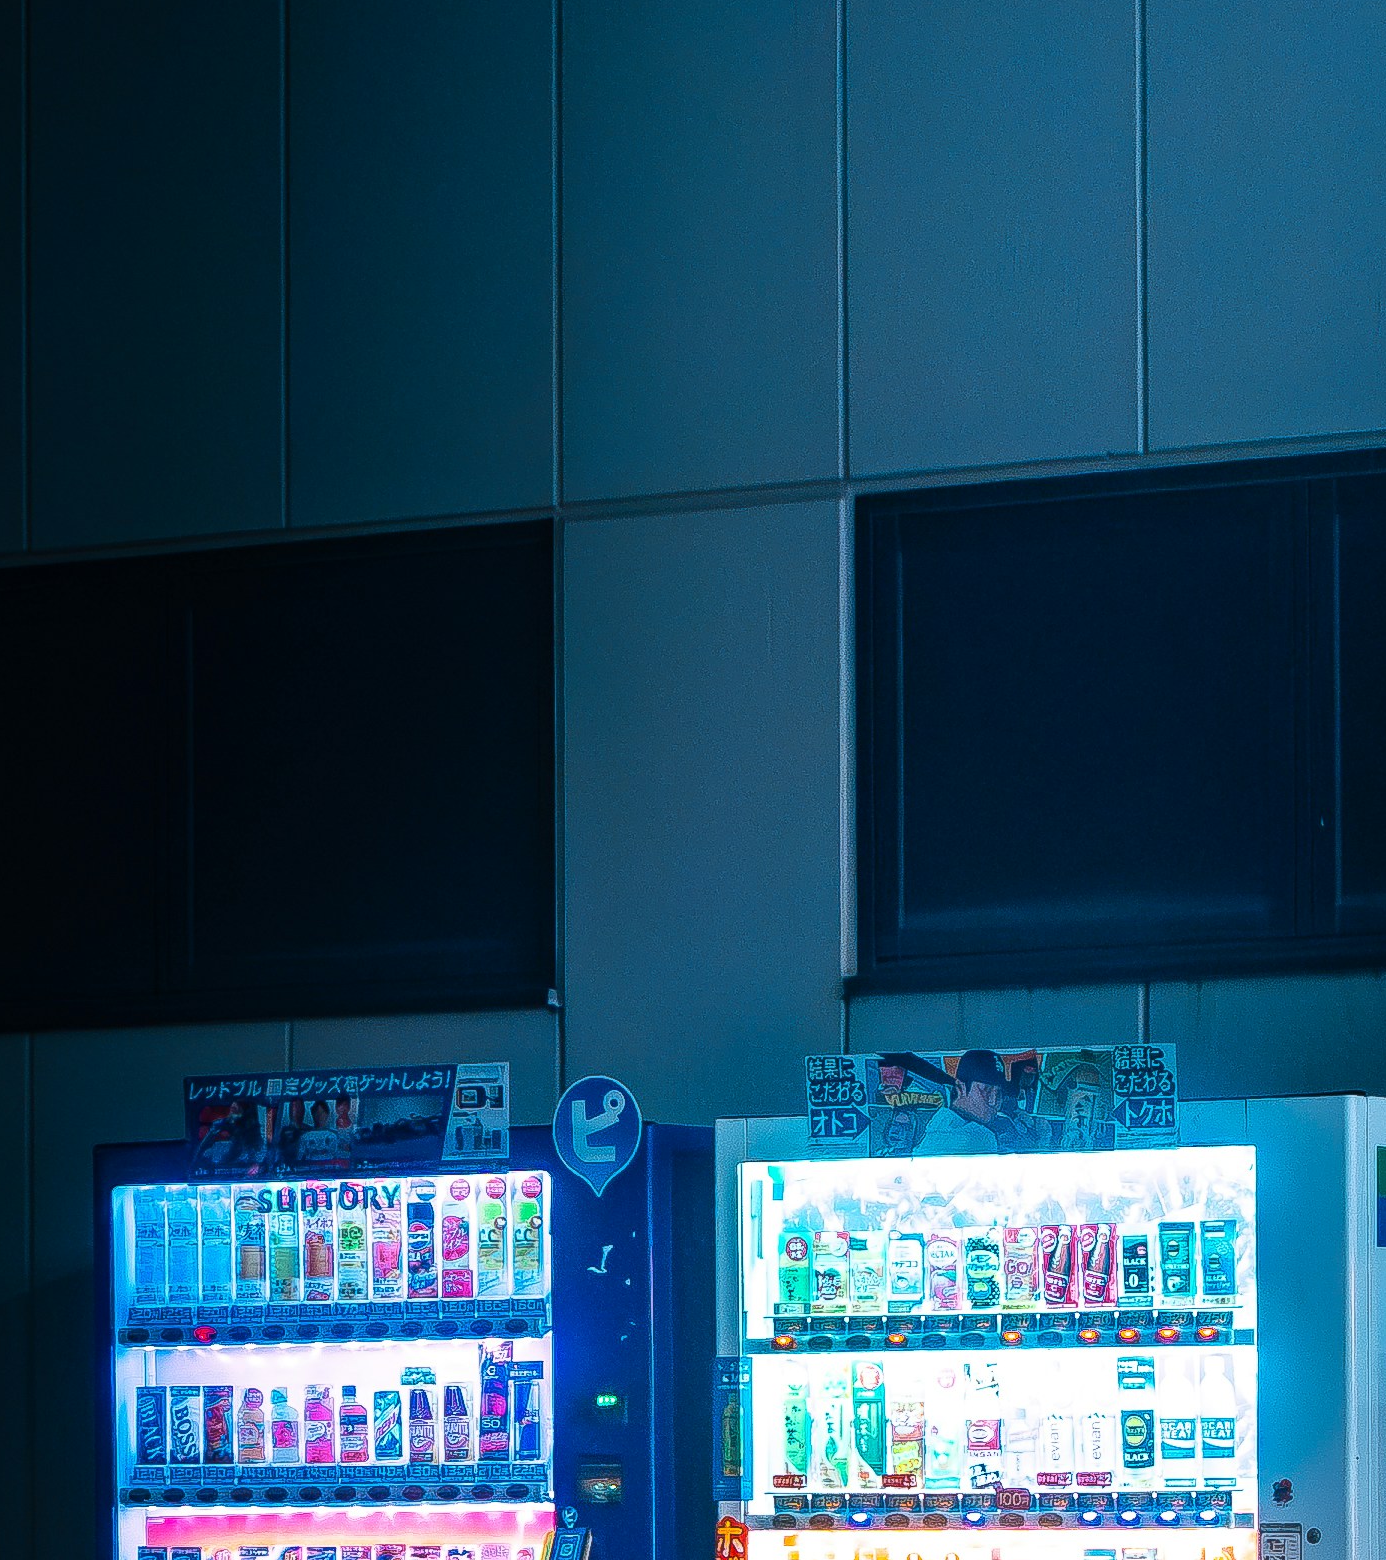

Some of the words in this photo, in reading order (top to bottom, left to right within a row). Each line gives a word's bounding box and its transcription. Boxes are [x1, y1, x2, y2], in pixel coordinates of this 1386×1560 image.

[809, 1058, 853, 1079] 結果に
[1115, 1048, 1160, 1070] 結果に
[189, 1078, 262, 1100] レッドブル
[810, 1081, 863, 1103] こだわる
[1115, 1071, 1171, 1093] こだわる
[571, 1090, 626, 1163] ピ
[813, 1110, 858, 1136] オトコ
[1126, 1101, 1173, 1128] トクホ
[174, 1405, 197, 1460] BOSS
[1050, 1420, 1062, 1462] evian
[1090, 1419, 1103, 1461] evian
